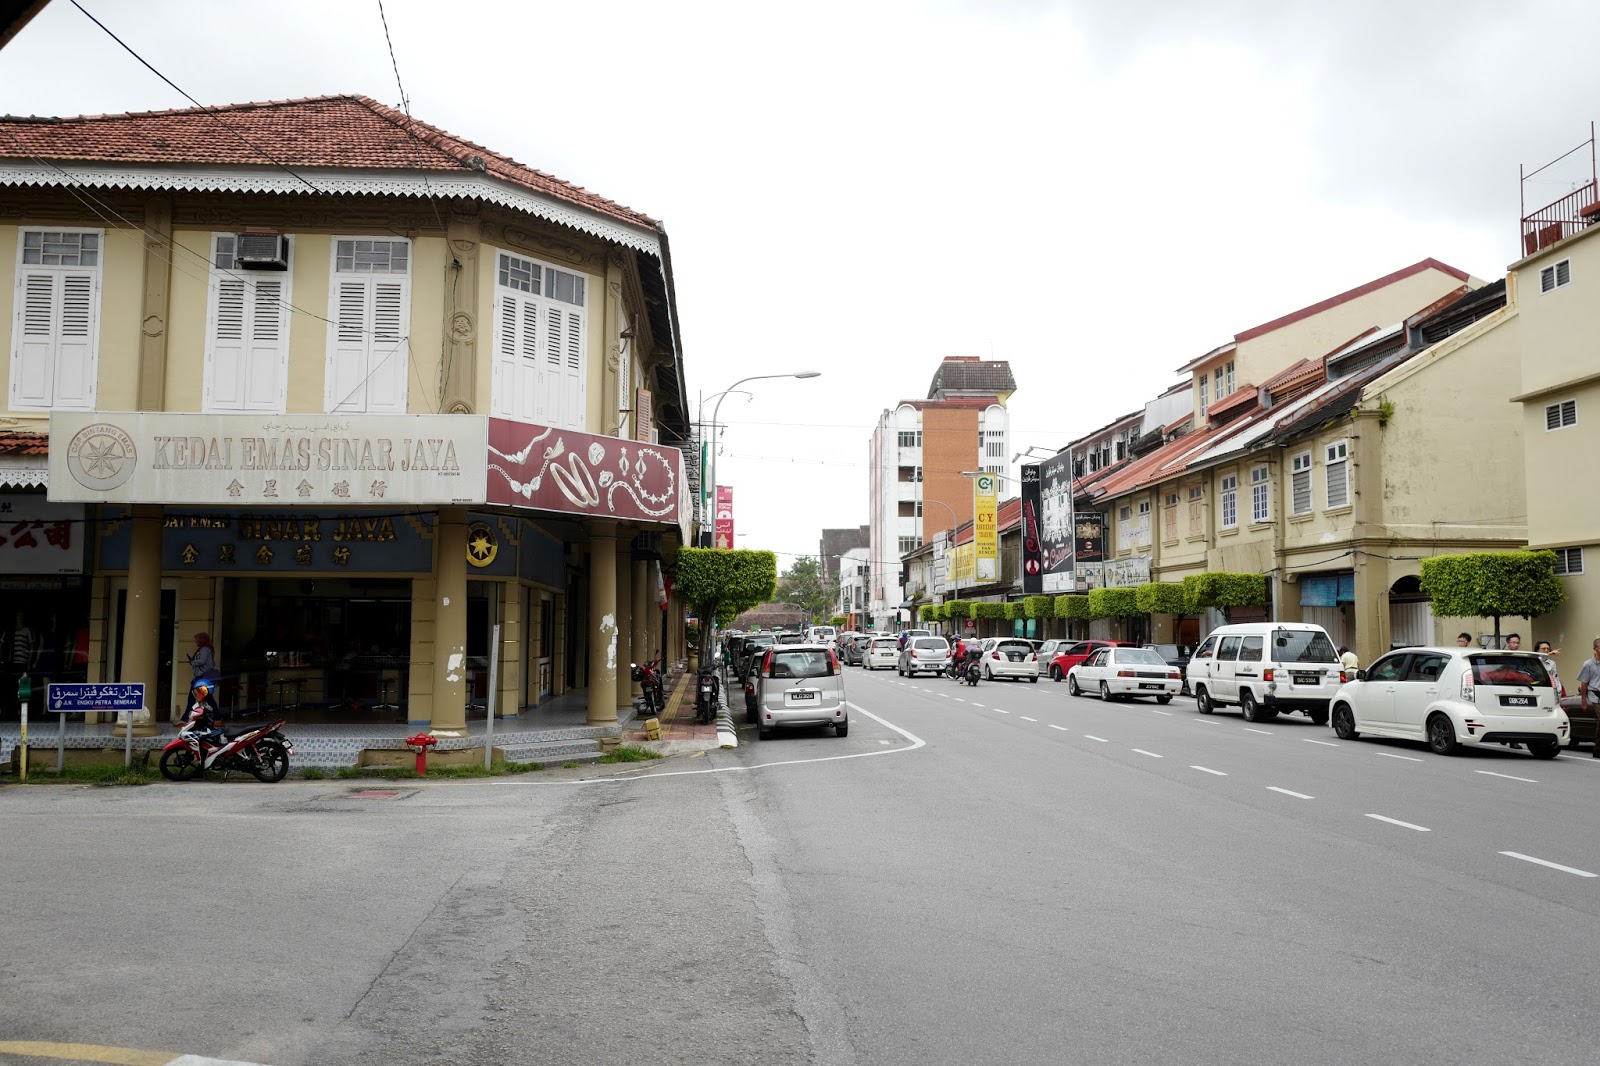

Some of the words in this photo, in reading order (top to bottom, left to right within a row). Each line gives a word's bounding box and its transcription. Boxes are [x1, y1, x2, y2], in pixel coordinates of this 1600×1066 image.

[71, 437, 82, 453] CAP
[82, 427, 117, 438] BINTANG
[117, 433, 133, 454] EMAS
[152, 436, 233, 470] KEDAI
[240, 437, 311, 472] EMAS
[317, 437, 395, 472] SINAR
[401, 438, 460, 472] JAYA
[0, 519, 71, 551] 公司
[333, 513, 397, 541] JAYA
[118, 685, 142, 699] جالن
